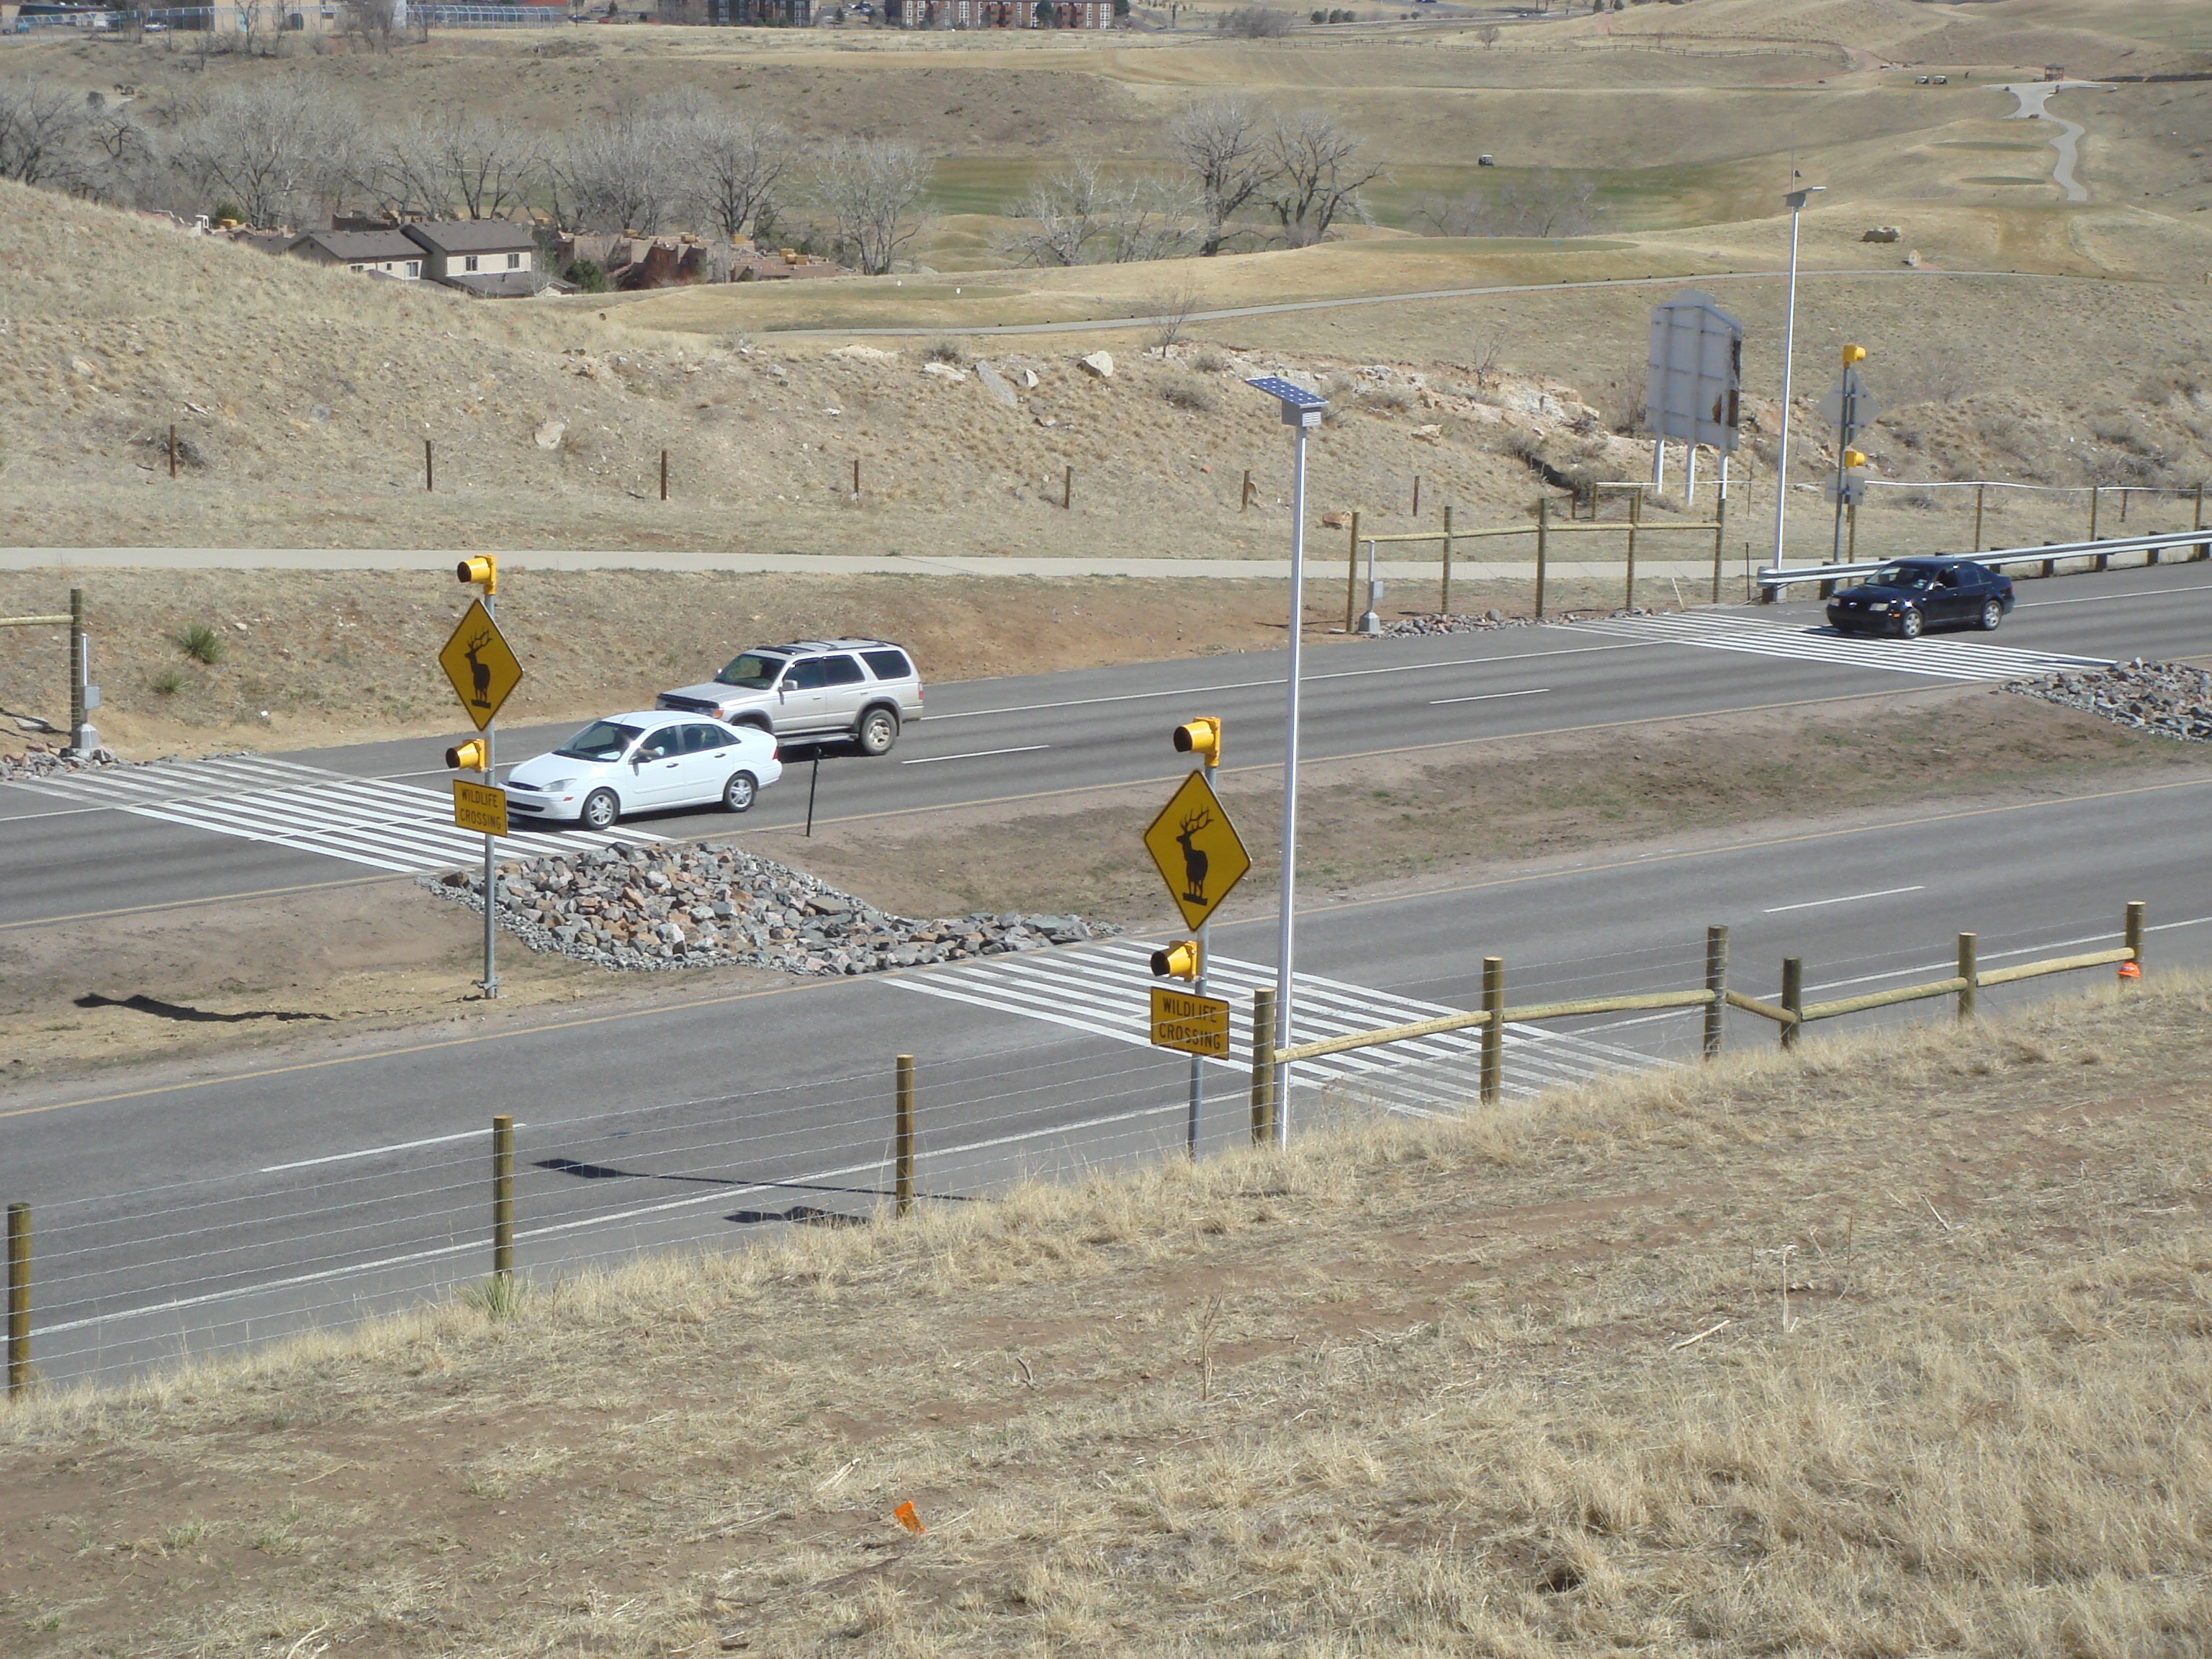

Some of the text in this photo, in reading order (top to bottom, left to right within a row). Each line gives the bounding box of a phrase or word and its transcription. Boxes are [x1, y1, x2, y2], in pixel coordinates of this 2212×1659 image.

[462, 788, 498, 807] WILDLIFE
[460, 809, 501, 830] CROSSING
[1163, 997, 1217, 1022] WILDLIFE
[1159, 1023, 1220, 1049] CROSSING
